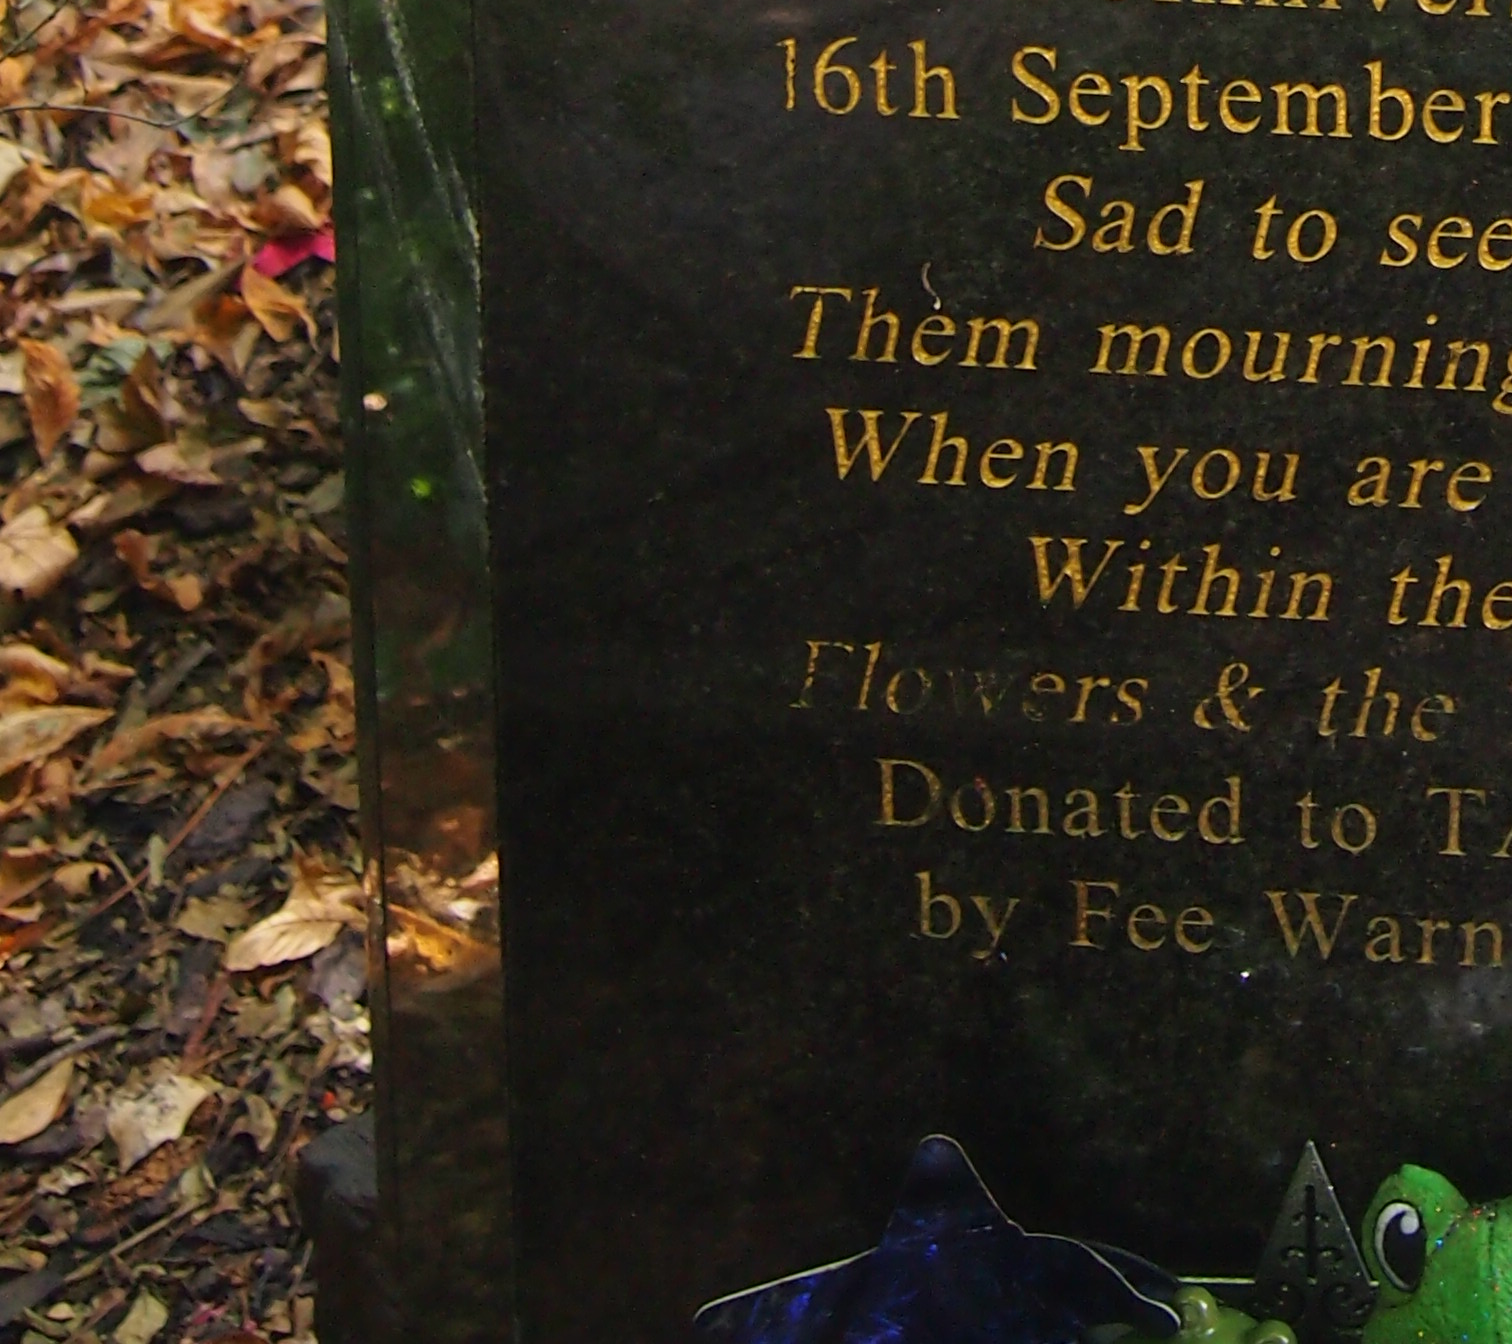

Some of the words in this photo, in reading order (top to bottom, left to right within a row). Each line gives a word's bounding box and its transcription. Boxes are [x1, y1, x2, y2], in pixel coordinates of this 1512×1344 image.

[779, 35, 960, 120] 16th
[1010, 42, 1512, 152] September
[1033, 172, 1205, 256] Sad
[1251, 194, 1339, 264] to
[789, 284, 1042, 370] Them
[826, 405, 1080, 492] When
[1123, 444, 1300, 515] you
[1346, 455, 1494, 512] are
[1029, 533, 1334, 621] Within
[1192, 660, 1264, 732] &
[1318, 665, 1456, 742] the
[877, 756, 1243, 845] Donated
[1297, 792, 1378, 853] to
[917, 869, 1019, 960] by
[1074, 877, 1215, 953] Fee
